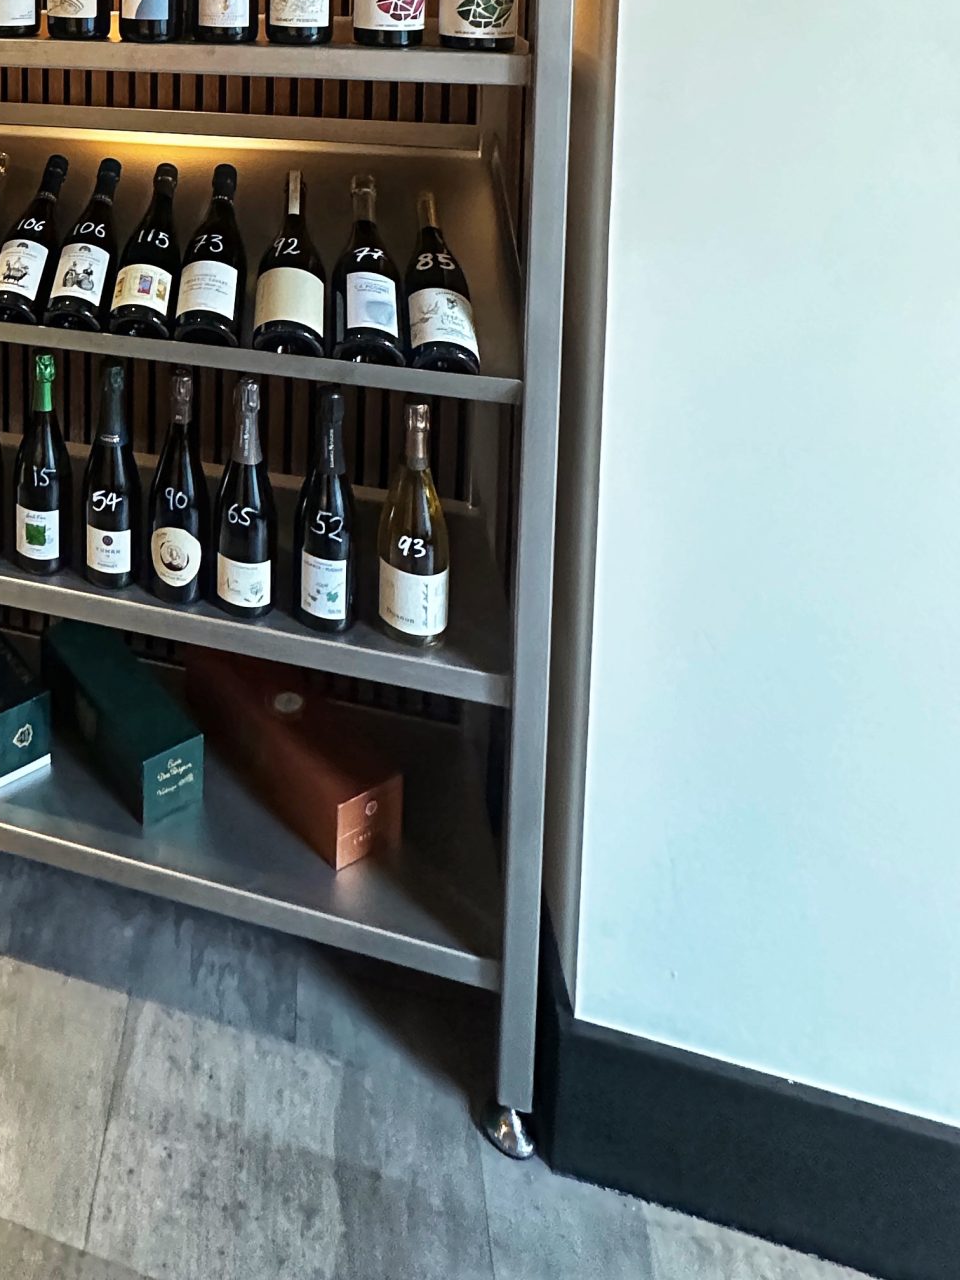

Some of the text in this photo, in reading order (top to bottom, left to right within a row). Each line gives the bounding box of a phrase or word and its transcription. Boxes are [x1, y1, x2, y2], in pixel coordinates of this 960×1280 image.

[17, 218, 44, 232] 106
[73, 221, 106, 238] 106
[138, 228, 170, 249] 115
[195, 234, 224, 253] 73
[416, 253, 456, 271] 85
[92, 490, 122, 512] 54
[165, 487, 189, 511] 90
[228, 503, 259, 526] 65
[310, 510, 344, 543] 52
[398, 535, 427, 558] 93
